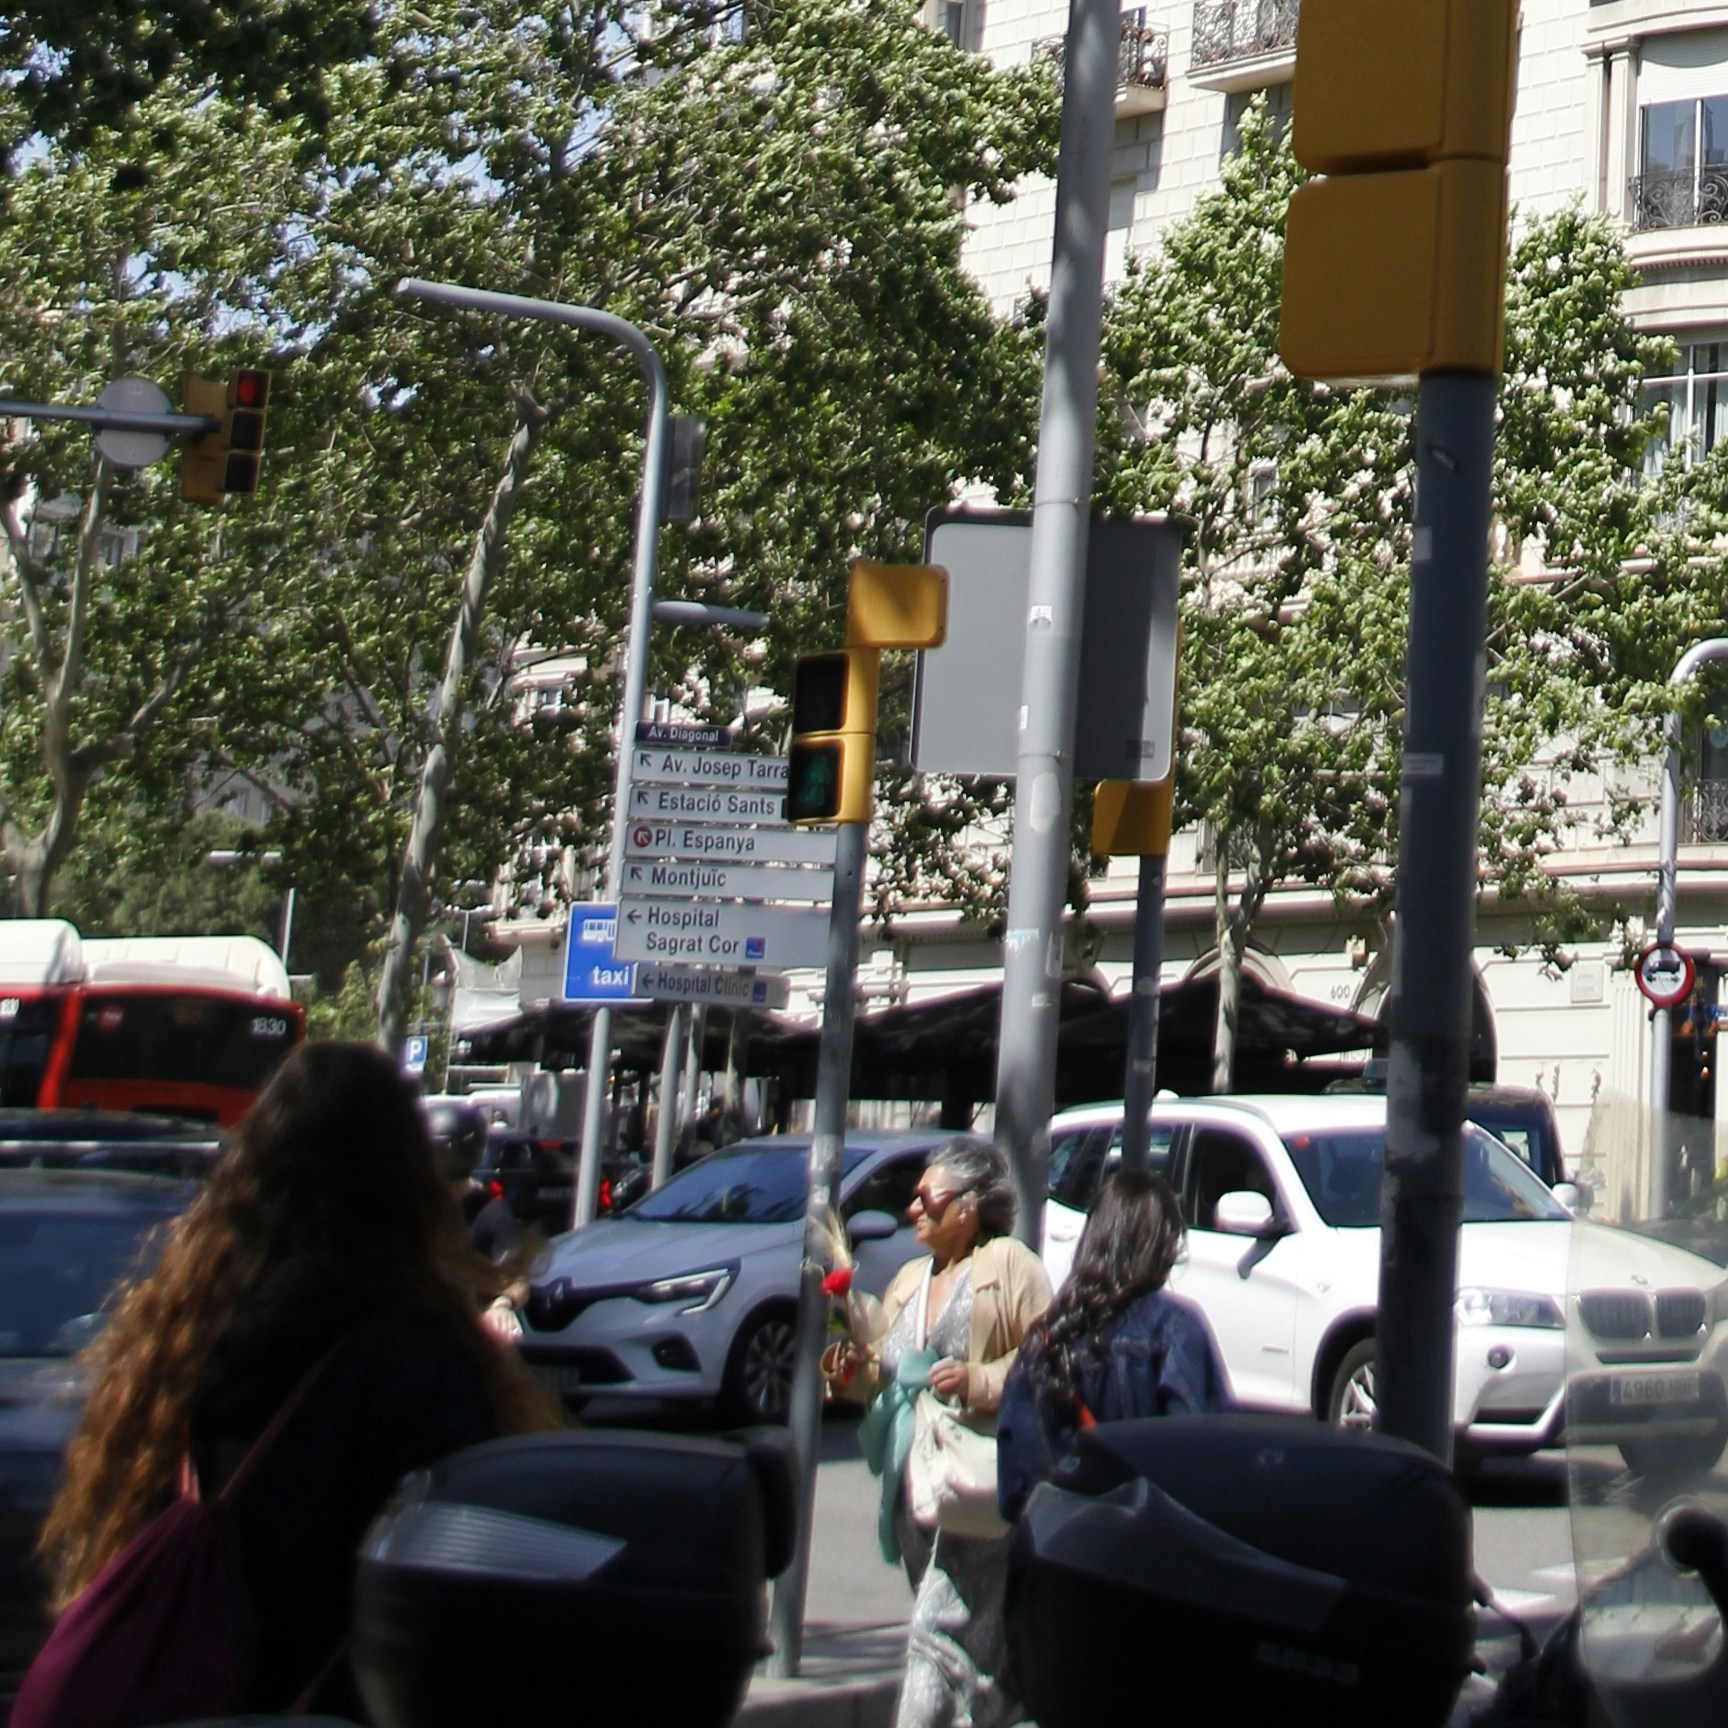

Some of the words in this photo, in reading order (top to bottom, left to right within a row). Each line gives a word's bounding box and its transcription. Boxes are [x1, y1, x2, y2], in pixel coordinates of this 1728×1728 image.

[649, 724, 666, 738] Av.
[670, 727, 718, 743] Diagonal
[662, 754, 687, 772] Av.
[693, 756, 741, 780] Josep
[748, 759, 788, 778] Tarra
[659, 791, 721, 811] Estació
[728, 797, 775, 814] Sants
[655, 829, 676, 847] Pl.
[684, 831, 755, 853] Espanya
[651, 865, 727, 890] Montjuïc
[648, 904, 720, 930] Hospital
[647, 932, 703, 955] Sagrat
[709, 938, 740, 954] Cor
[592, 965, 629, 986] taxi
[658, 970, 711, 993] Hospital
[1330, 985, 1351, 999] 600
